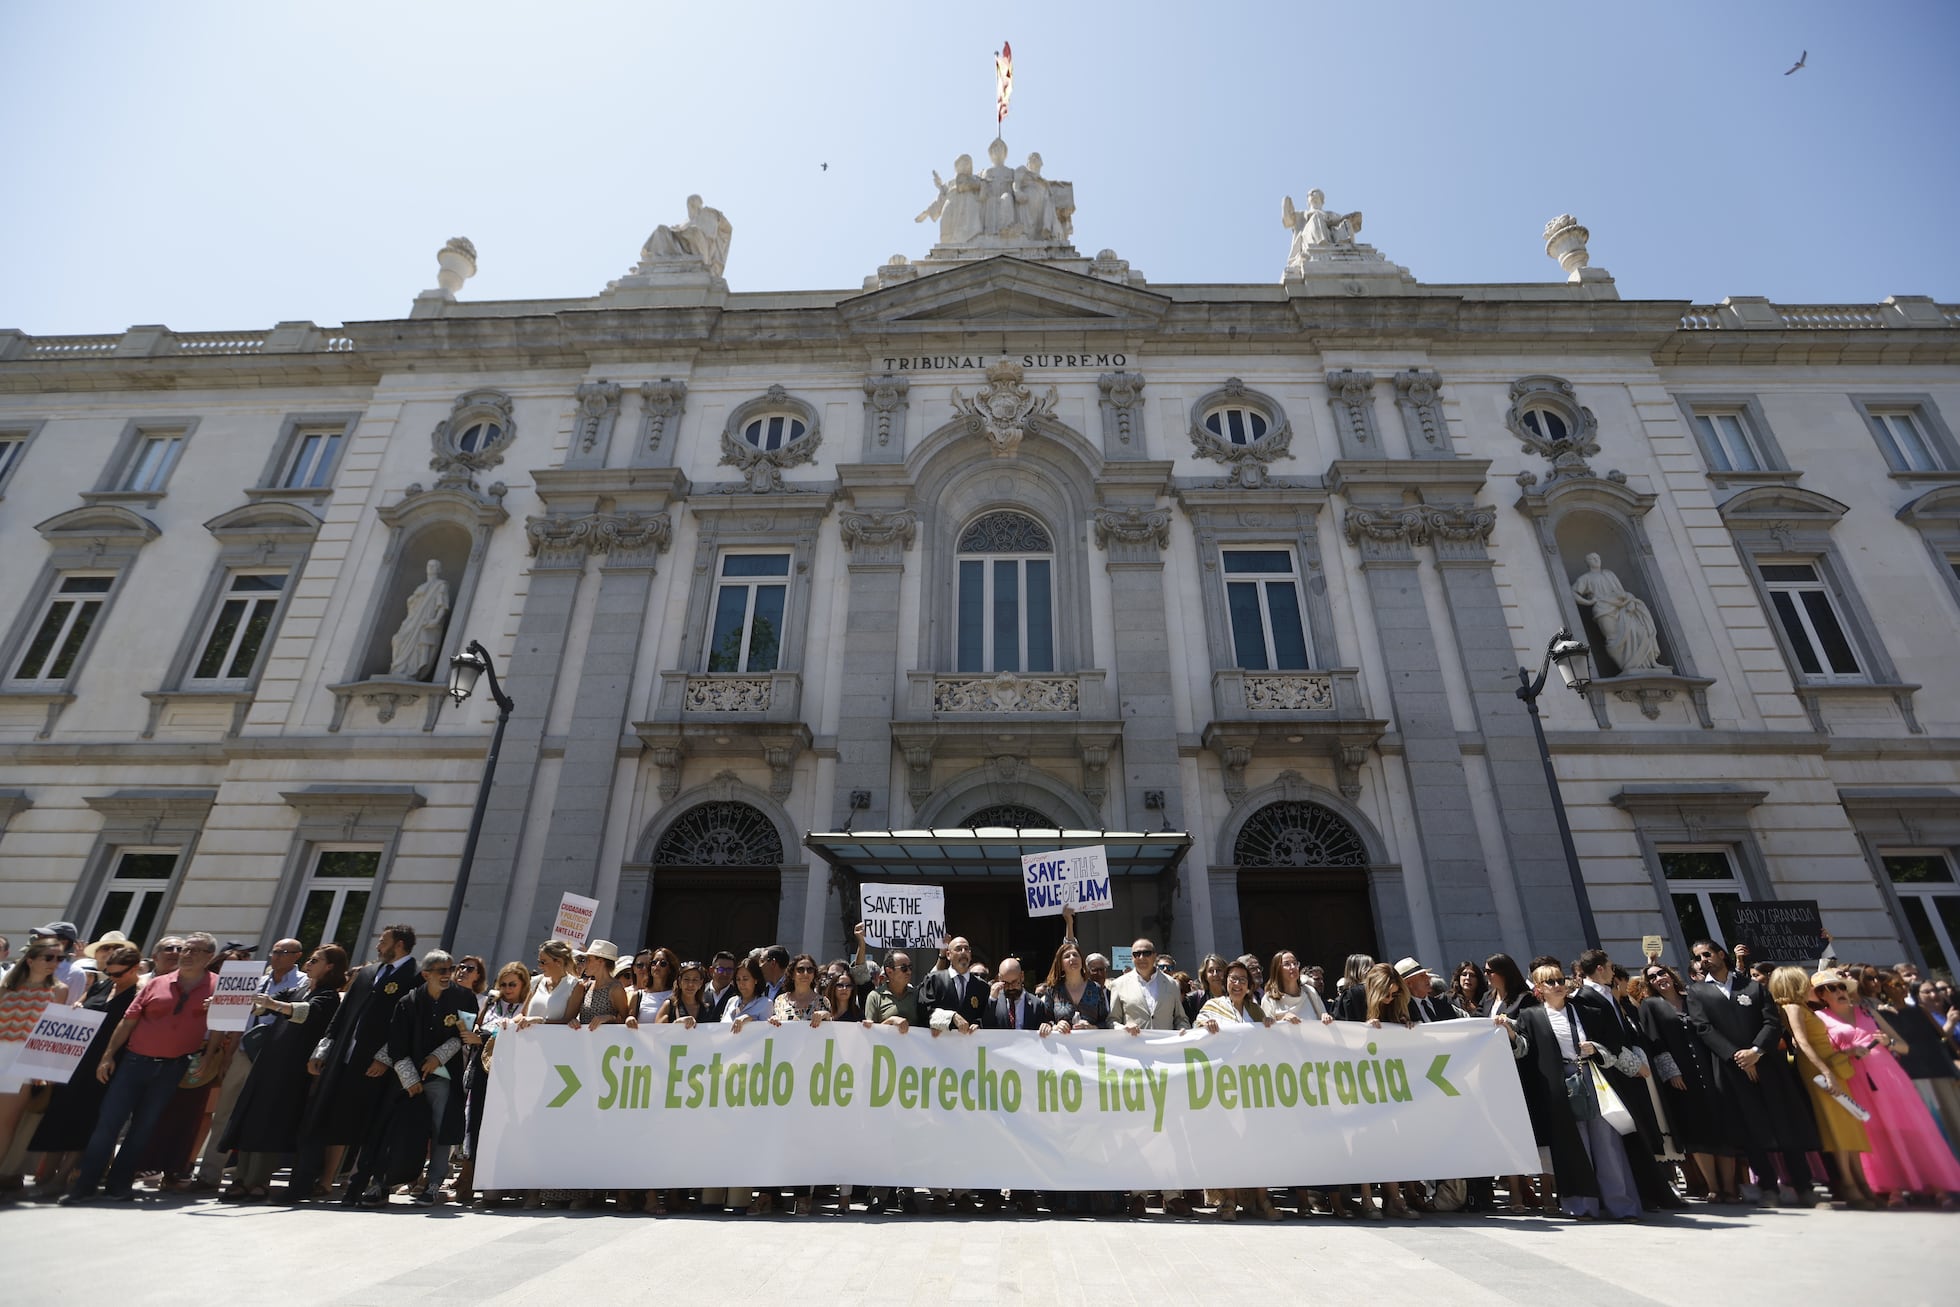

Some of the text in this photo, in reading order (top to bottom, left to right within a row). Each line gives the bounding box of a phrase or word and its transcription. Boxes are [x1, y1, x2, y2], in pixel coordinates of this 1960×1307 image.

[883, 354, 1127, 370] TRIBUNAL SUPREMO
[1071, 856, 1100, 879] THE
[1063, 881, 1078, 903] OF
[1078, 877, 1109, 903] LAW
[898, 897, 922, 915] THE
[1760, 910, 1766, 922] Y
[1768, 907, 1815, 923] GRANADA
[555, 926, 568, 935] ANTE
[574, 931, 584, 939] LEY
[901, 920, 915, 938] OF
[918, 920, 945, 938] LAW
[1761, 924, 1792, 935] POR LA
[881, 938, 936, 949] IN SPAIN
[1767, 948, 1813, 960] JUDICIAL
[217, 976, 259, 991] FISCALES
[212, 994, 253, 1006] INDEPENDIENTE
[35, 1019, 94, 1042] FISCALES
[25, 1038, 86, 1057] INDEPENDIENTES
[597, 1038, 1414, 1133] Sin Estado de Derecho no hay Democracia
